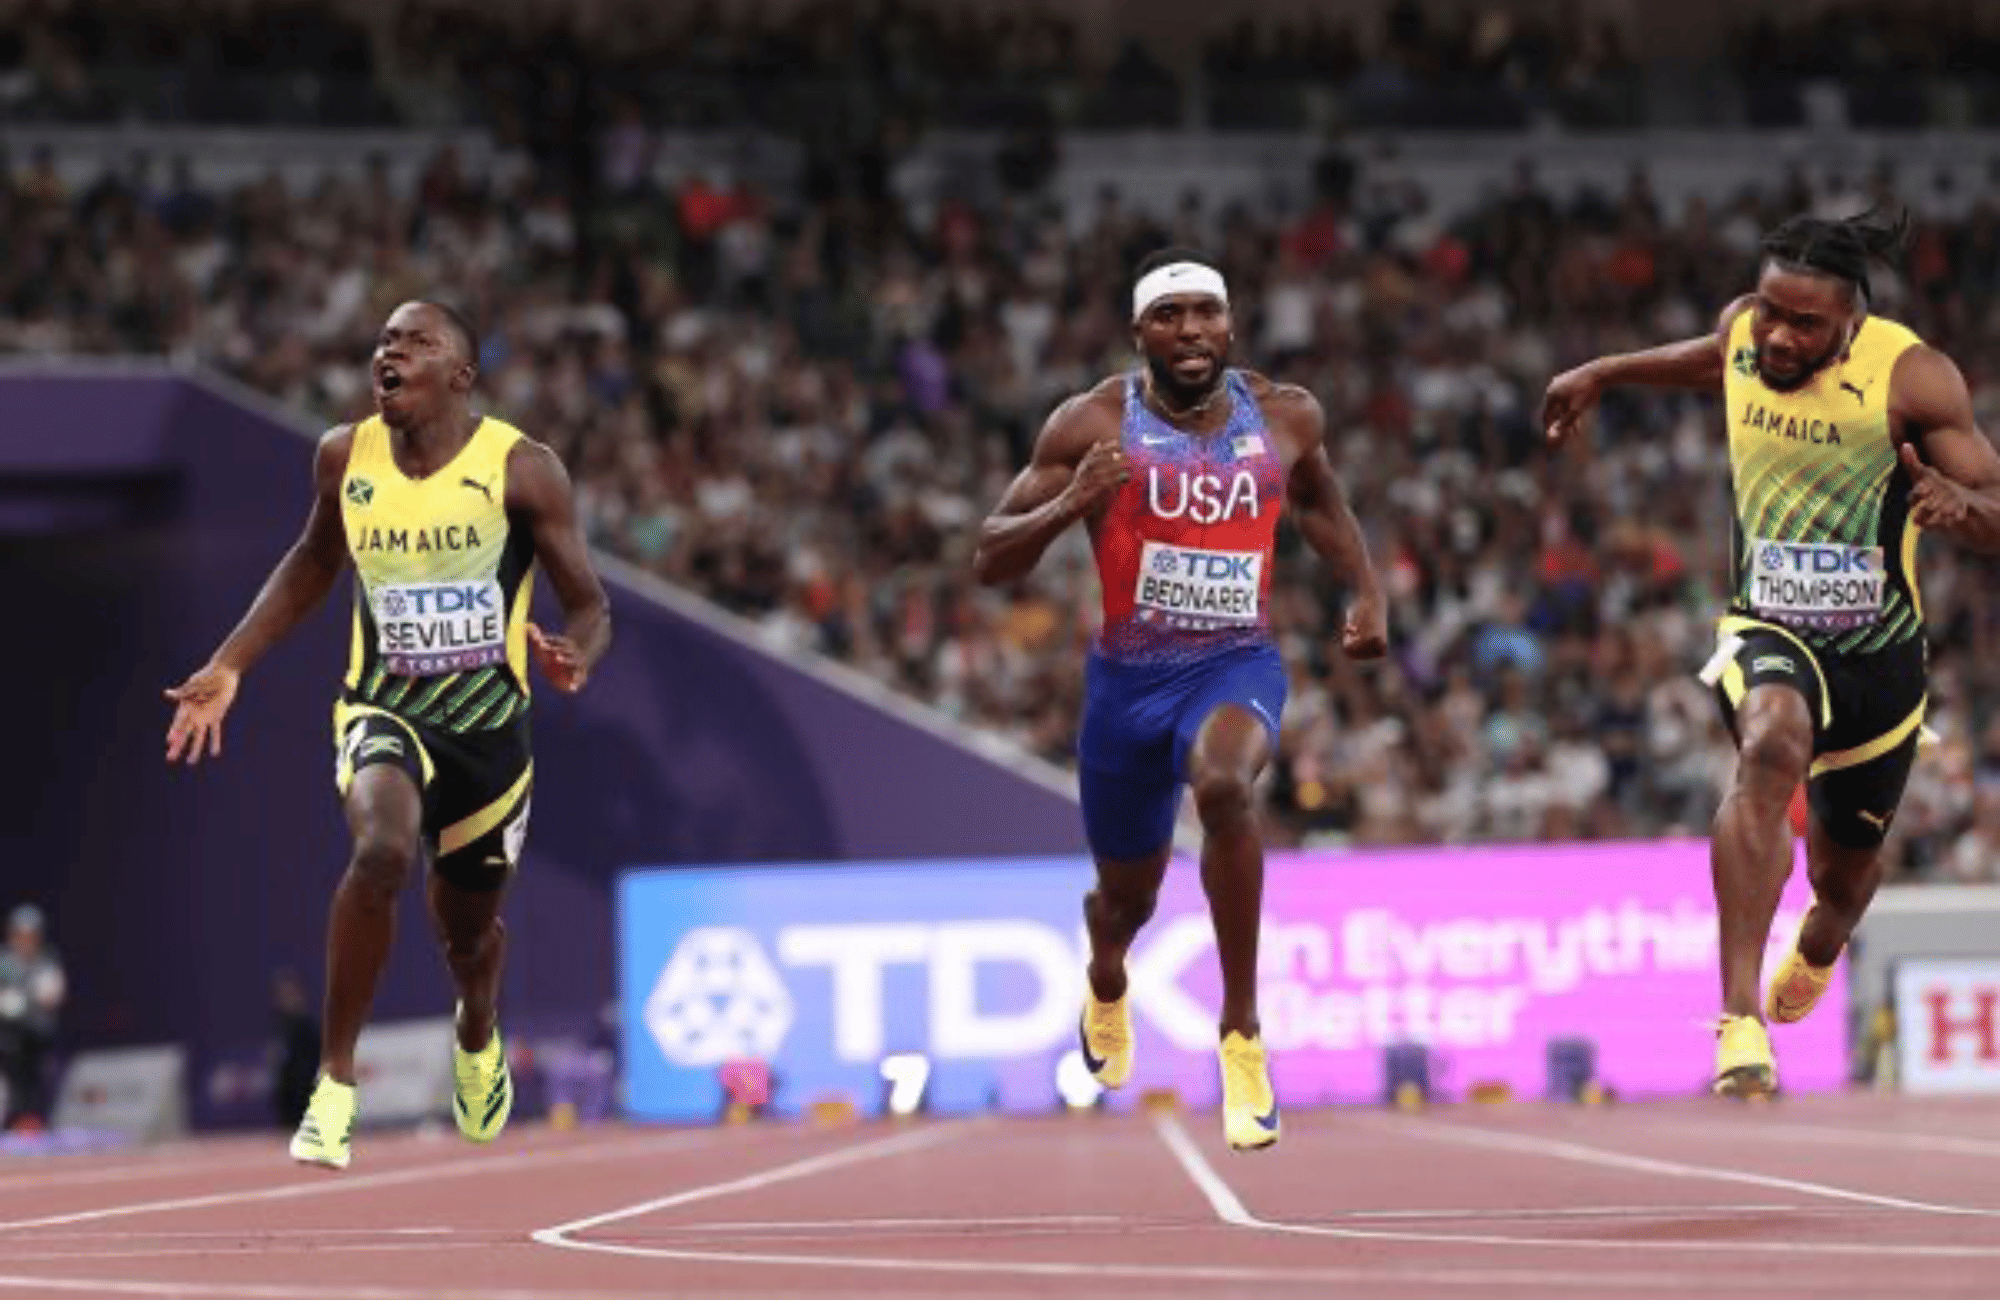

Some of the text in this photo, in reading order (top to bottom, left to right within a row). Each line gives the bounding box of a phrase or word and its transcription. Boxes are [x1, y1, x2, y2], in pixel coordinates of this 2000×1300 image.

[1741, 402, 1842, 445] JAMAICA
[1149, 466, 1258, 524] USA
[355, 525, 482, 553] JAMAICA
[1180, 552, 1253, 581] TDK
[1784, 546, 1870, 573] TDK
[405, 586, 494, 614] TDK
[1143, 576, 1254, 613] BEDNAREK
[1757, 576, 1878, 607] THOMPSON
[383, 614, 498, 650] SEVILLE
[1343, 897, 1797, 992] Everythi
[777, 919, 1224, 1064] TDK
